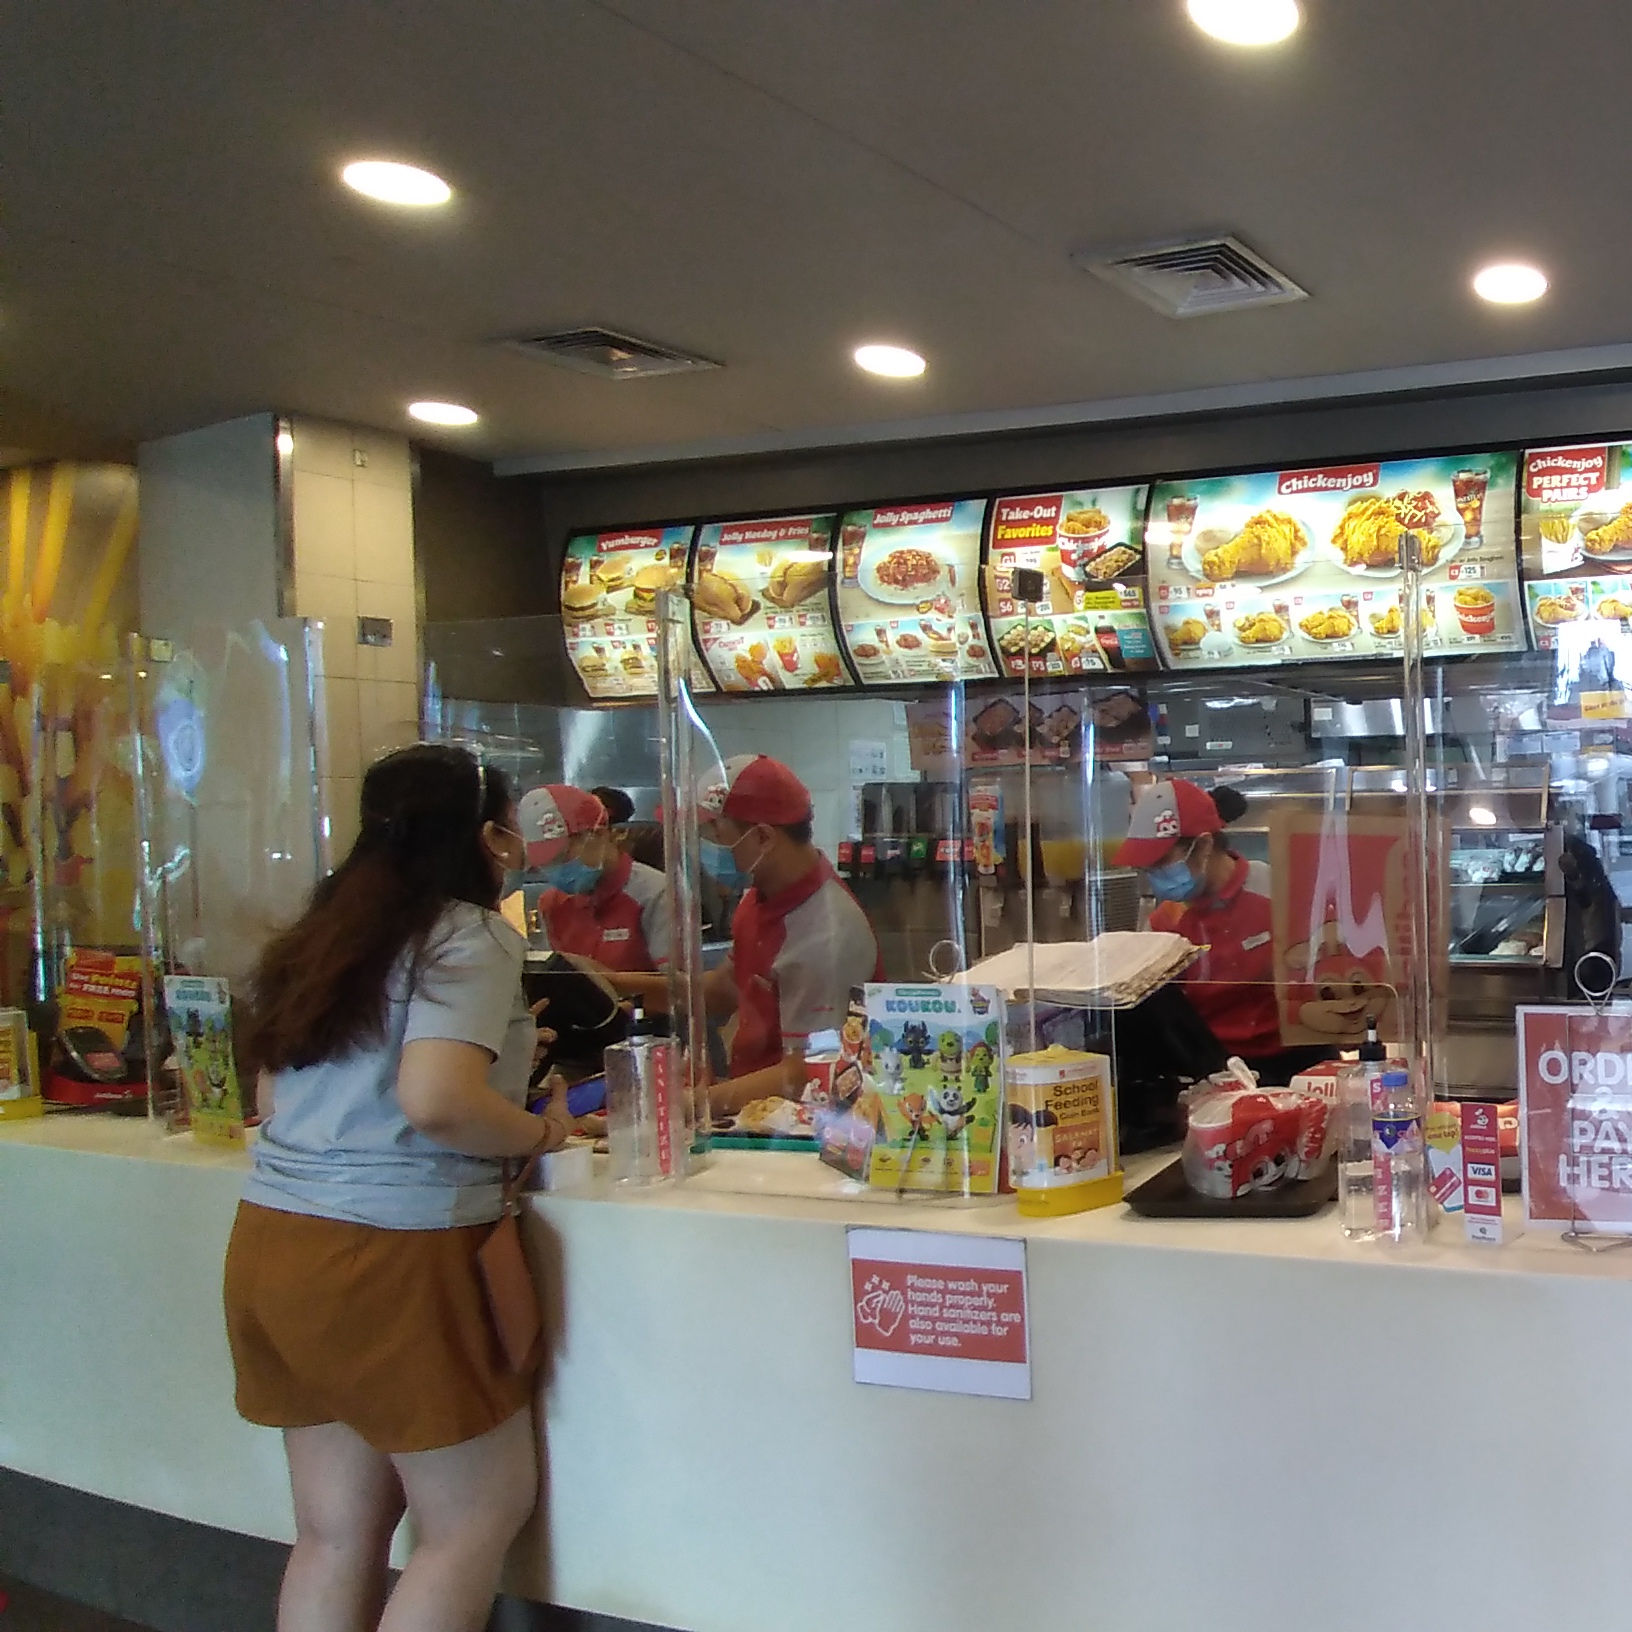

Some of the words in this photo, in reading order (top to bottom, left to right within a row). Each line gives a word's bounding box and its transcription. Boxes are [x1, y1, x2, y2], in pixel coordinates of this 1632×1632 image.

[1529, 456, 1603, 472] Chickenjoy
[1280, 470, 1374, 493] Chickenjoy
[1533, 472, 1600, 489] PERFECT
[1542, 487, 1589, 503] PAIRS
[874, 513, 899, 526] Jolly
[899, 507, 953, 524] Spaghetti
[1001, 505, 1057, 521] Take-Out
[722, 531, 743, 542] Jolly
[745, 529, 777, 540] Hotdog
[788, 526, 811, 536] Fries
[997, 523, 1054, 539] Favorites
[601, 534, 659, 551] Yumburger
[1054, 1081, 1098, 1097] School
[1045, 1095, 1099, 1111] Feeding
[1470, 1166, 1493, 1177] VISA
[907, 1274, 945, 1290] Please
[948, 1279, 979, 1291] wash
[982, 1282, 1010, 1296] your
[907, 1288, 943, 1303] hands
[945, 1293, 997, 1309] properly.
[908, 1304, 940, 1317] Hand
[942, 1307, 997, 1321] sanitizers
[1000, 1312, 1022, 1323] are
[909, 1317, 933, 1330] also
[935, 1320, 988, 1335] available
[991, 1323, 1009, 1336] for
[909, 1332, 936, 1346] your
[938, 1335, 962, 1347] use.
